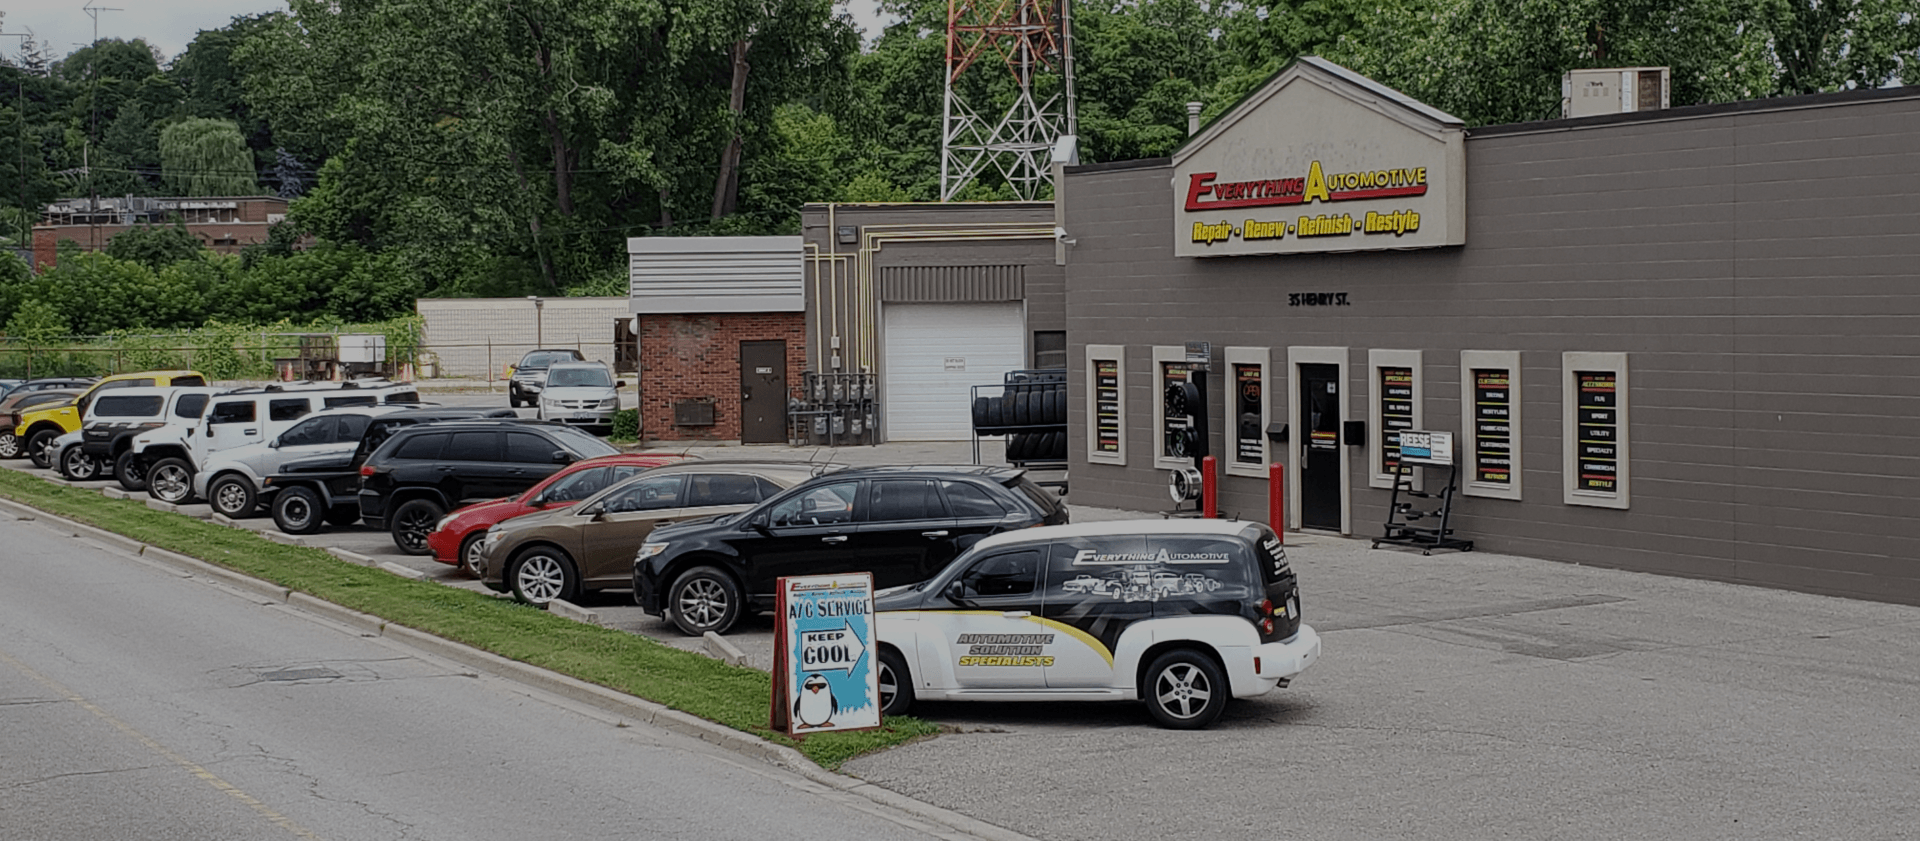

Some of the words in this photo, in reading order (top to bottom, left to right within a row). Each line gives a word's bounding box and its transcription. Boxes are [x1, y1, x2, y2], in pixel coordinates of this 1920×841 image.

[1185, 172, 1304, 211] EVERYTHING
[1303, 161, 1427, 202] AUTOMOTIVE
[1192, 220, 1232, 245] Repair
[1243, 219, 1286, 241] Renew
[1297, 215, 1352, 238] Refinish
[1364, 210, 1420, 236] Restyle
[1288, 293, 1300, 306] 35
[1301, 293, 1334, 306] HENRY
[1335, 293, 1350, 306] ST.
[1400, 433, 1430, 448] REESE
[1072, 549, 1156, 565] EVERYTHING
[1155, 548, 1229, 564] AUTOMOTIVE
[789, 602, 813, 619] A/C
[818, 598, 871, 617] SERVICE
[808, 633, 844, 642] KEEP
[956, 634, 1055, 645] AUTOMOTIVE
[803, 645, 856, 665] COOL
[969, 645, 1043, 656] SOLUTION
[959, 656, 1055, 667] SPECIALISTS
